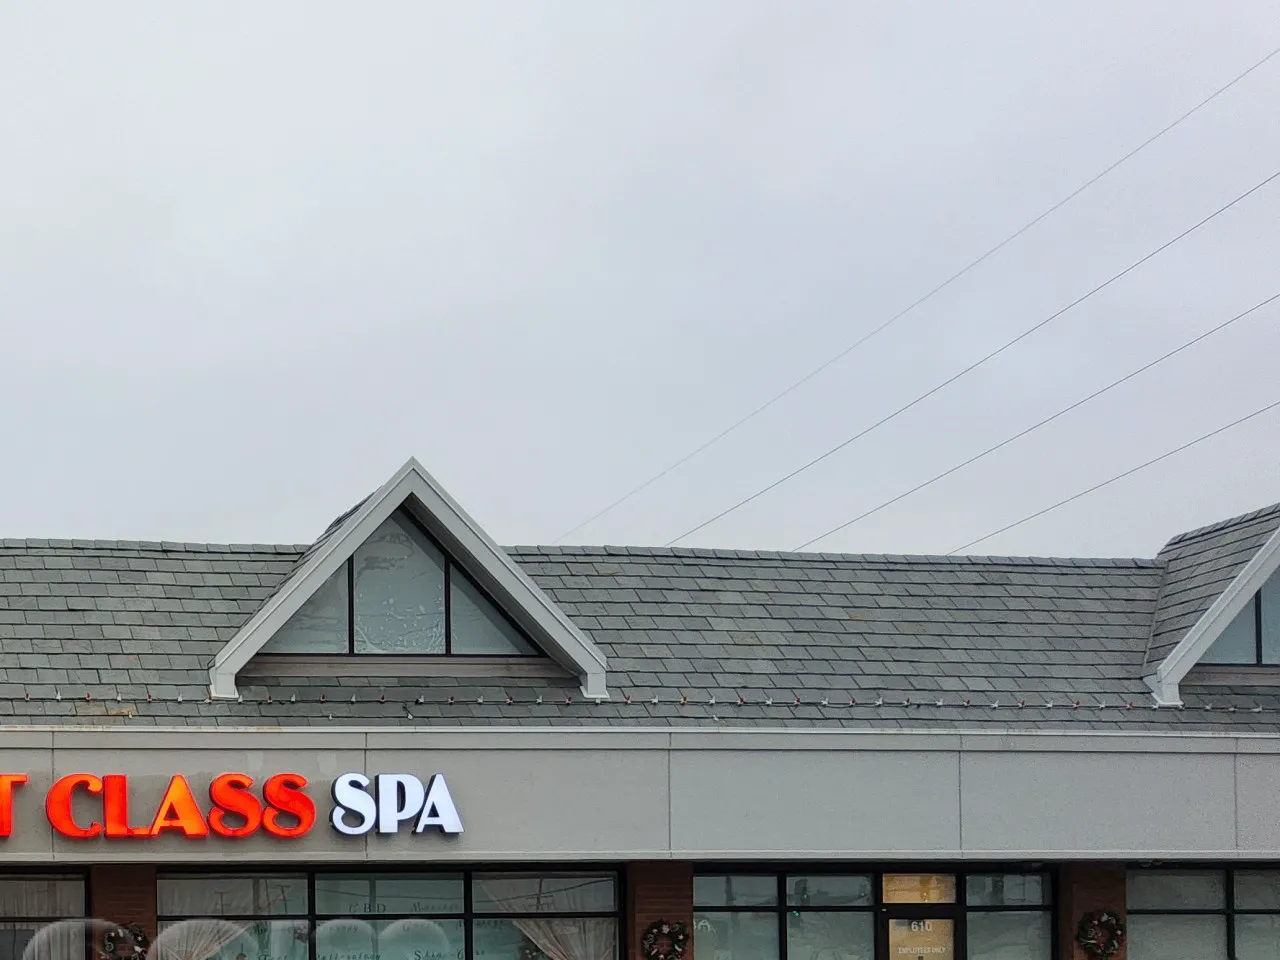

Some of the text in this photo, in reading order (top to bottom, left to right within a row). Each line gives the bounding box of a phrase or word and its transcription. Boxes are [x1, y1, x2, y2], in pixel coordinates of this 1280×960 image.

[46, 772, 317, 839] CLASS
[331, 771, 465, 837] SPA
[911, 921, 933, 932] 610
